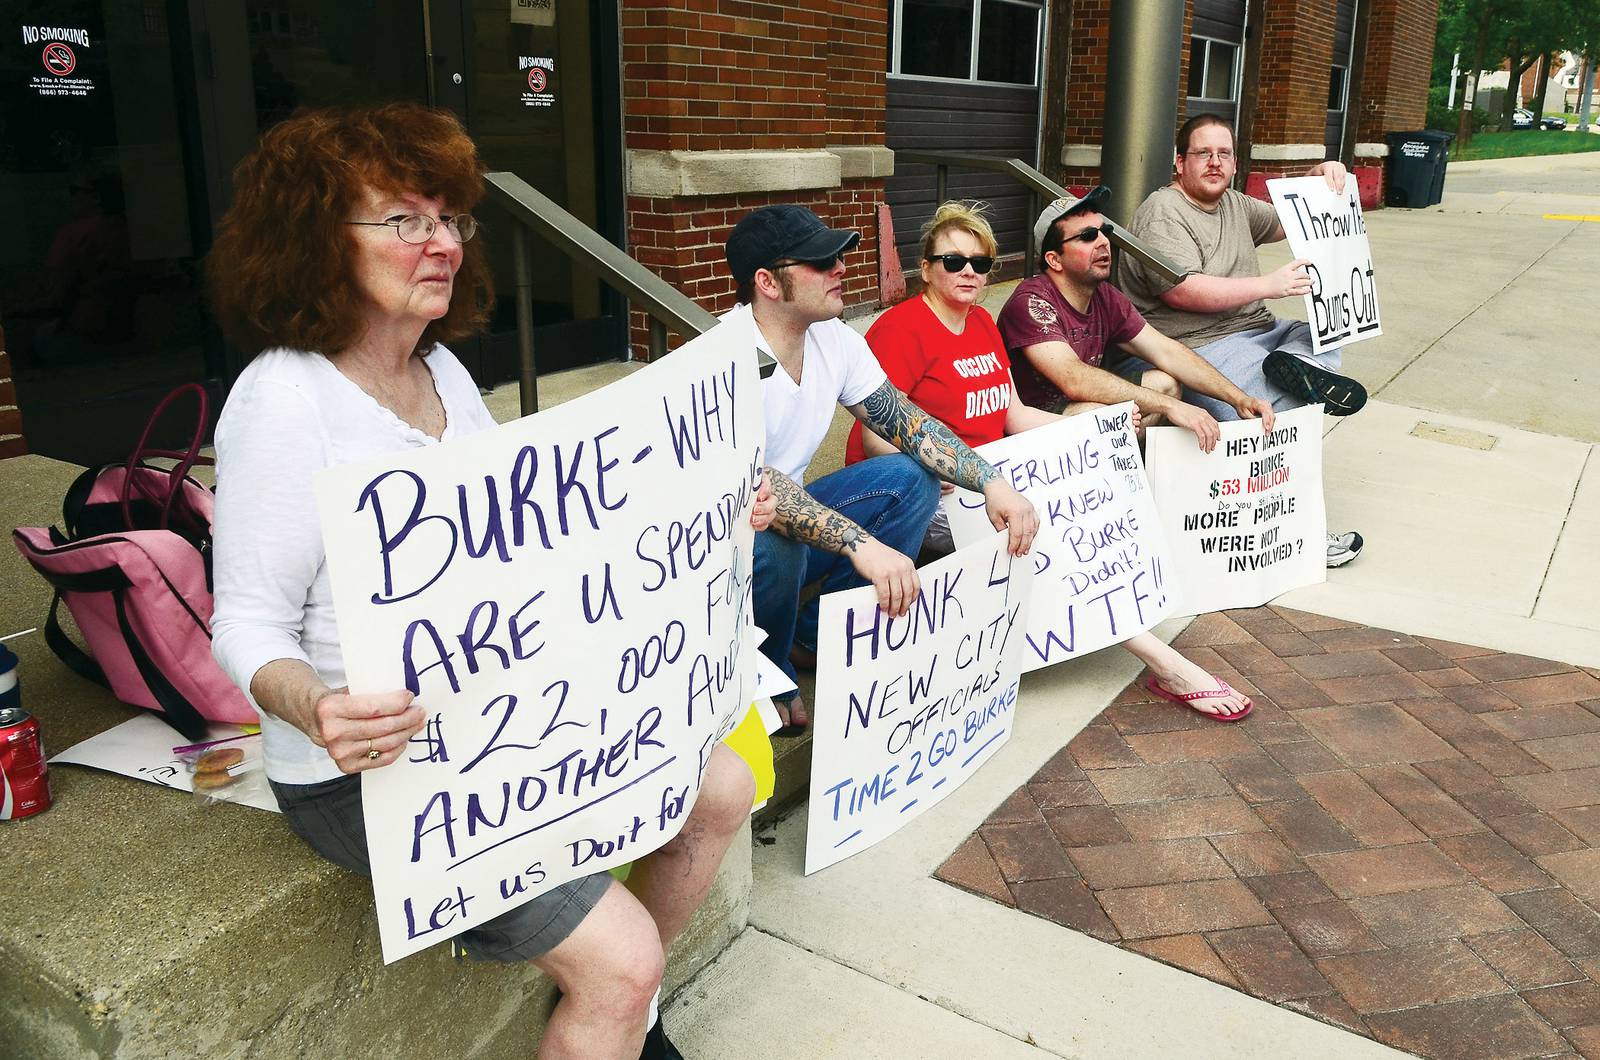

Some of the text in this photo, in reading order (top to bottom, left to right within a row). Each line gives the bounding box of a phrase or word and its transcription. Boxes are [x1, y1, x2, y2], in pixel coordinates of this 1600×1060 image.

[23, 26, 89, 47] NO SMOKING
[519, 56, 554, 71] NO SMOKING
[1284, 193, 1350, 241] Throw
[1305, 259, 1378, 338] Bums Out
[952, 351, 1003, 379] OCCUPY
[663, 360, 737, 469] WHY
[965, 382, 1011, 420] DIXON
[1094, 411, 1131, 435] LOWER
[1111, 432, 1133, 449] OUR
[1226, 426, 1299, 457] HEY MAYOR
[958, 439, 1099, 510] TERLING
[1108, 453, 1138, 472] TAXES
[1209, 478, 1241, 500] $53
[1247, 466, 1290, 494] MILLION
[1249, 451, 1285, 478] BURKE
[1047, 478, 1114, 527] KNEW
[1184, 509, 1240, 532] MORE
[1253, 497, 1296, 525] PEOPLE
[1062, 508, 1139, 563] BURKE
[1200, 526, 1280, 554] WERE NOT
[1228, 542, 1293, 573] INVOLVED
[845, 567, 964, 668] HONK
[403, 590, 546, 697] ARE
[843, 601, 1021, 739] NEW CITY
[887, 660, 1001, 755] OFFICIALS
[823, 680, 1018, 822] TIME 2 GO BURKE
[411, 706, 666, 863] ANOTHER
[404, 886, 475, 940] Let
[500, 861, 547, 900] us
[655, 785, 690, 832] for
